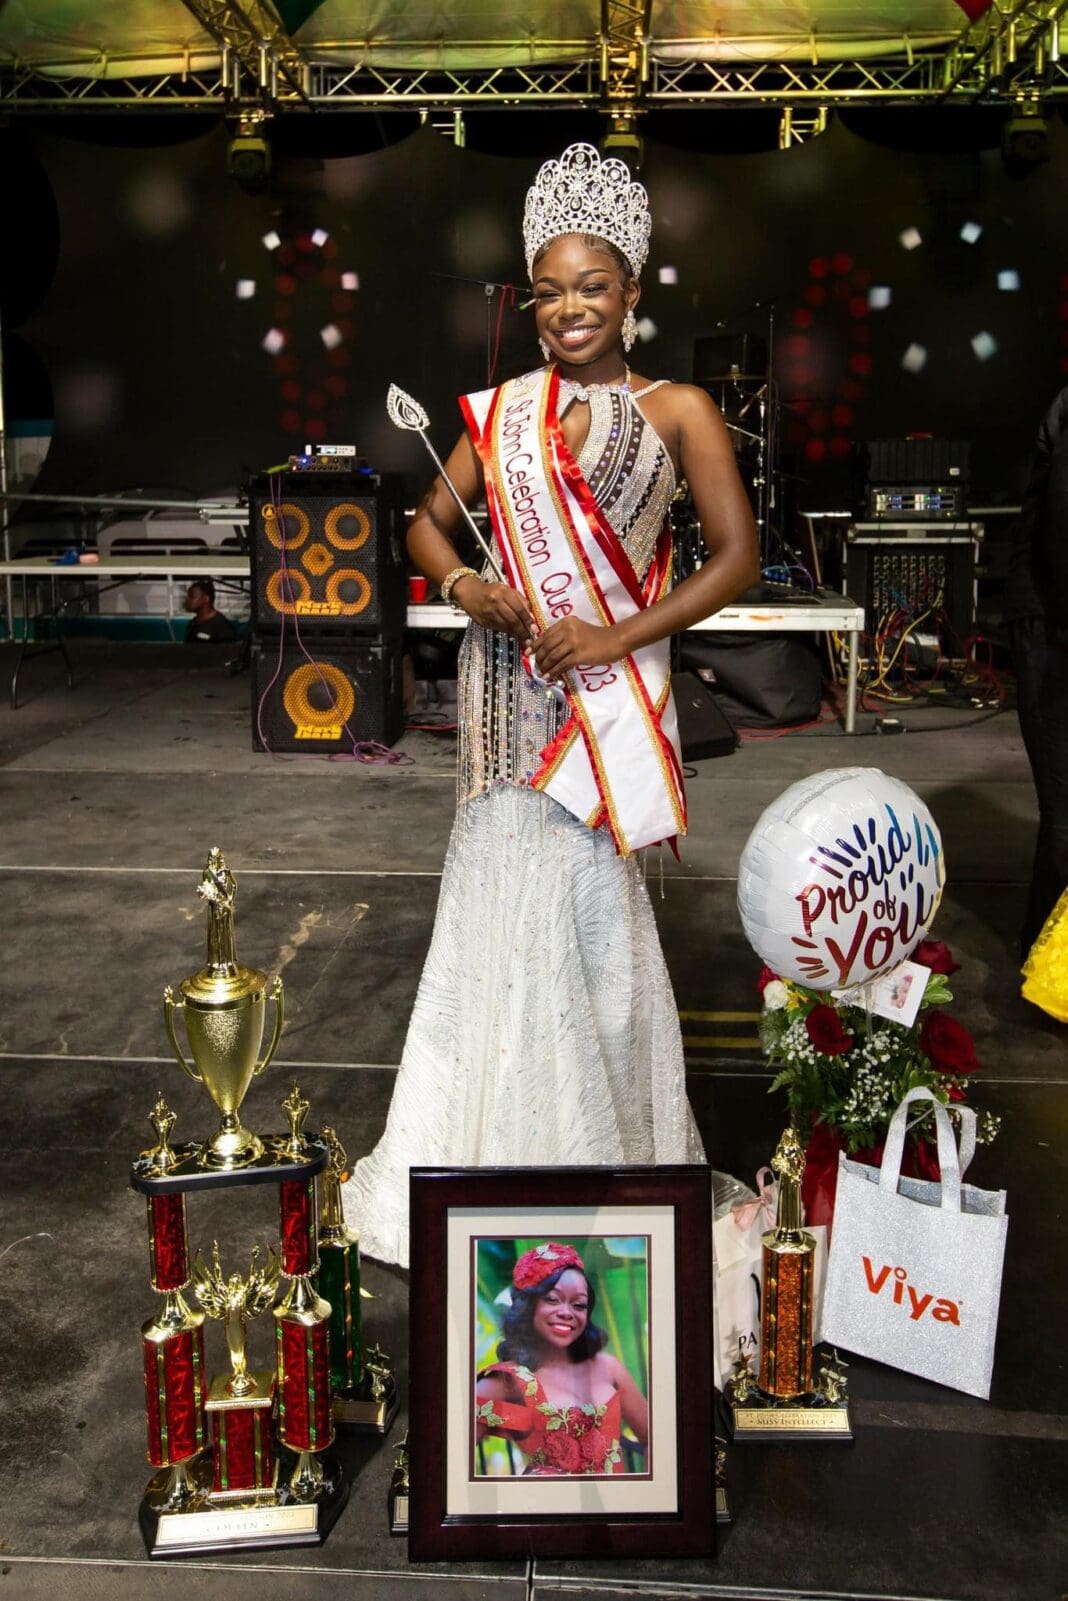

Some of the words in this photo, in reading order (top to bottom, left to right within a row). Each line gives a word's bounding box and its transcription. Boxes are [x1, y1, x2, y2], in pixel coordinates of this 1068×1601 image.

[502, 414, 531, 458] John
[505, 453, 551, 567] Celebration
[540, 572, 574, 619] Que
[873, 880, 896, 921] of
[862, 1255, 960, 1327] Viya
